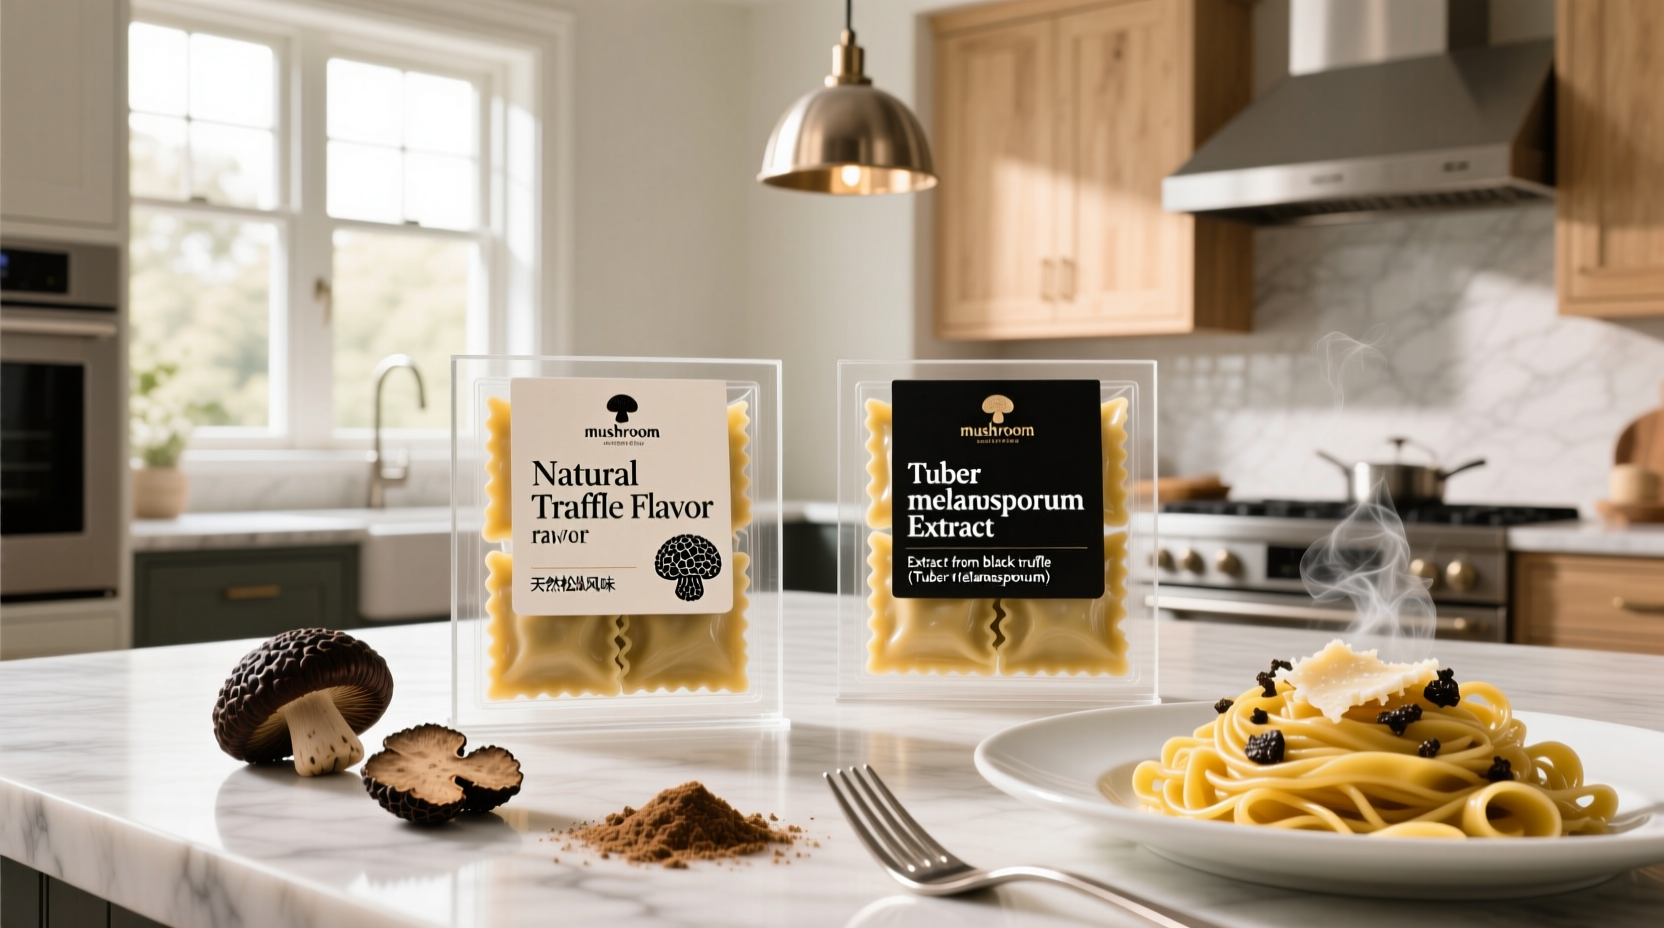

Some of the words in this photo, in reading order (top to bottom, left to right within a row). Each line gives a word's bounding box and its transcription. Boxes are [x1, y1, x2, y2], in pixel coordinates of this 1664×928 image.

[585, 424, 660, 438] mushroom
[961, 423, 1034, 437] mushroom
[531, 459, 639, 487] Natural
[908, 461, 981, 484] Tuber
[531, 492, 624, 519] Traffle
[631, 492, 714, 519] Flavor
[907, 514, 995, 538] Extract
[907, 555, 949, 568] Extract
[952, 555, 980, 568] from
[983, 555, 1015, 568] black
[908, 569, 949, 586] (Tuber
